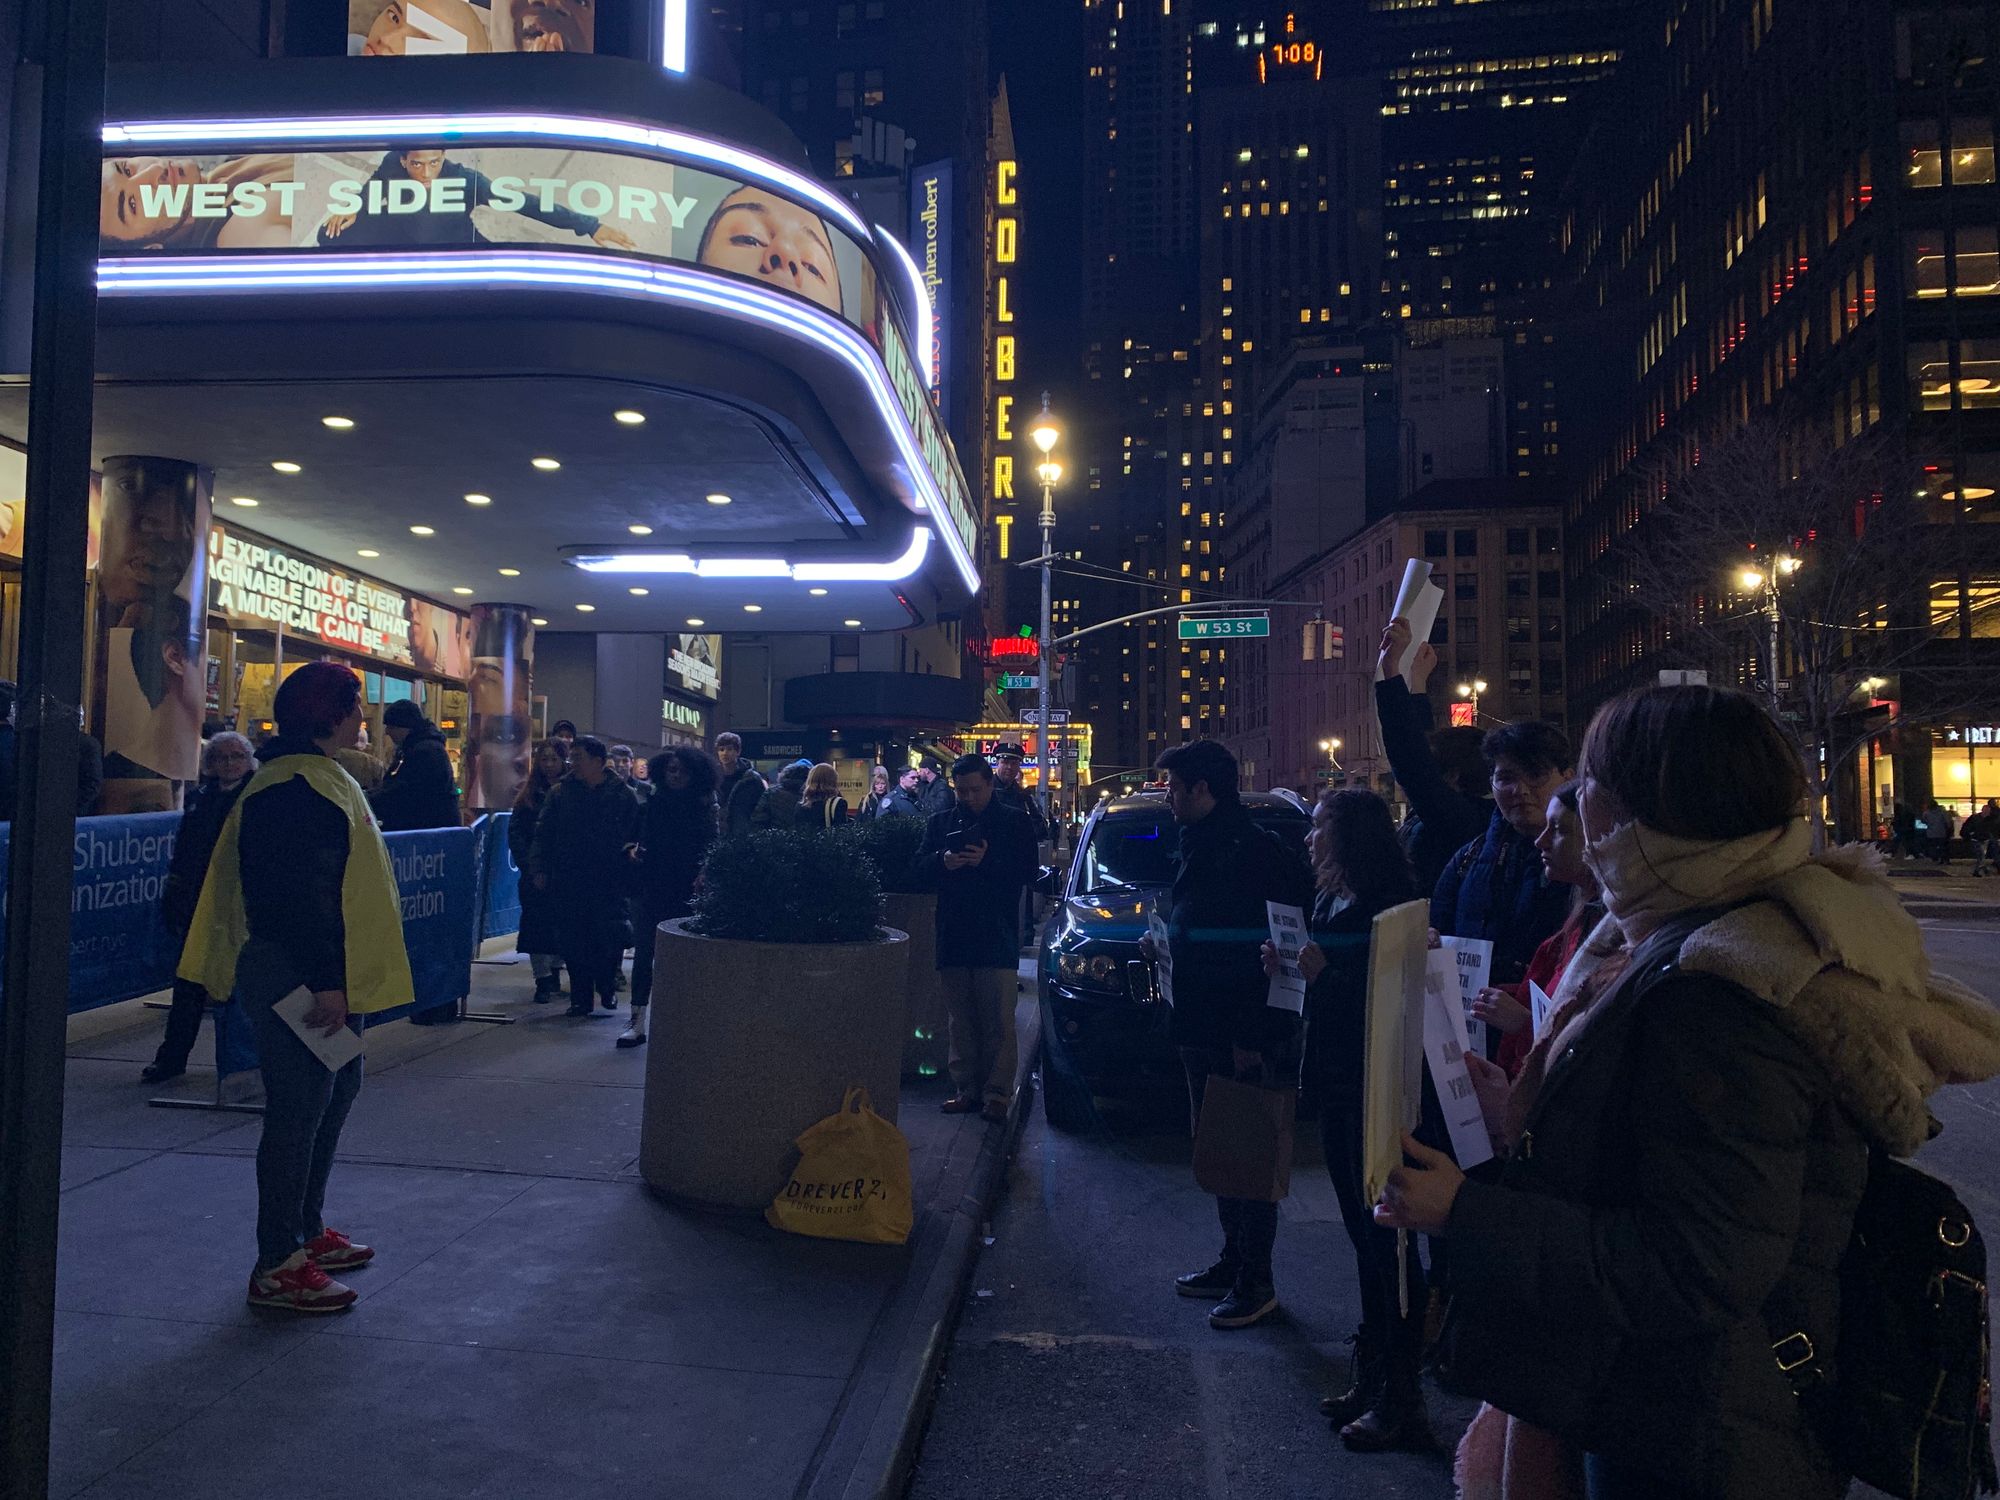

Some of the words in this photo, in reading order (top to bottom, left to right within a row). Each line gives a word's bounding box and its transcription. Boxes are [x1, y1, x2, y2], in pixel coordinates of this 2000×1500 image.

[139, 181, 304, 219] WEST
[327, 177, 466, 216] SIDE
[489, 175, 699, 228] STORY
[921, 177, 938, 240] colbert
[994, 160, 1017, 559] COLBERT
[884, 310, 924, 440] WEST
[924, 412, 949, 500] SIDE
[209, 555, 303, 606] AGINABLE
[304, 587, 344, 619] IDEA
[346, 601, 368, 625] OF
[370, 608, 410, 638] WHAT
[222, 533, 330, 592] EXPLOSION
[332, 575, 354, 598] OF
[357, 583, 406, 618] EVERY
[218, 584, 234, 609] A
[238, 589, 321, 633] MUSICAL
[324, 616, 360, 643] CAN
[1196, 623, 1208, 633] W
[1213, 622, 1231, 633] 53
[1237, 622, 1252, 632] St
[1014, 678, 1023, 687] 53
[1023, 756, 1059, 765] colrt
[73, 828, 175, 871] Shubert
[391, 844, 446, 882] hubert
[71, 868, 169, 913] nizatio
[400, 885, 445, 920] zation
[1456, 951, 1482, 968] STAND
[1458, 973, 1469, 989] TH
